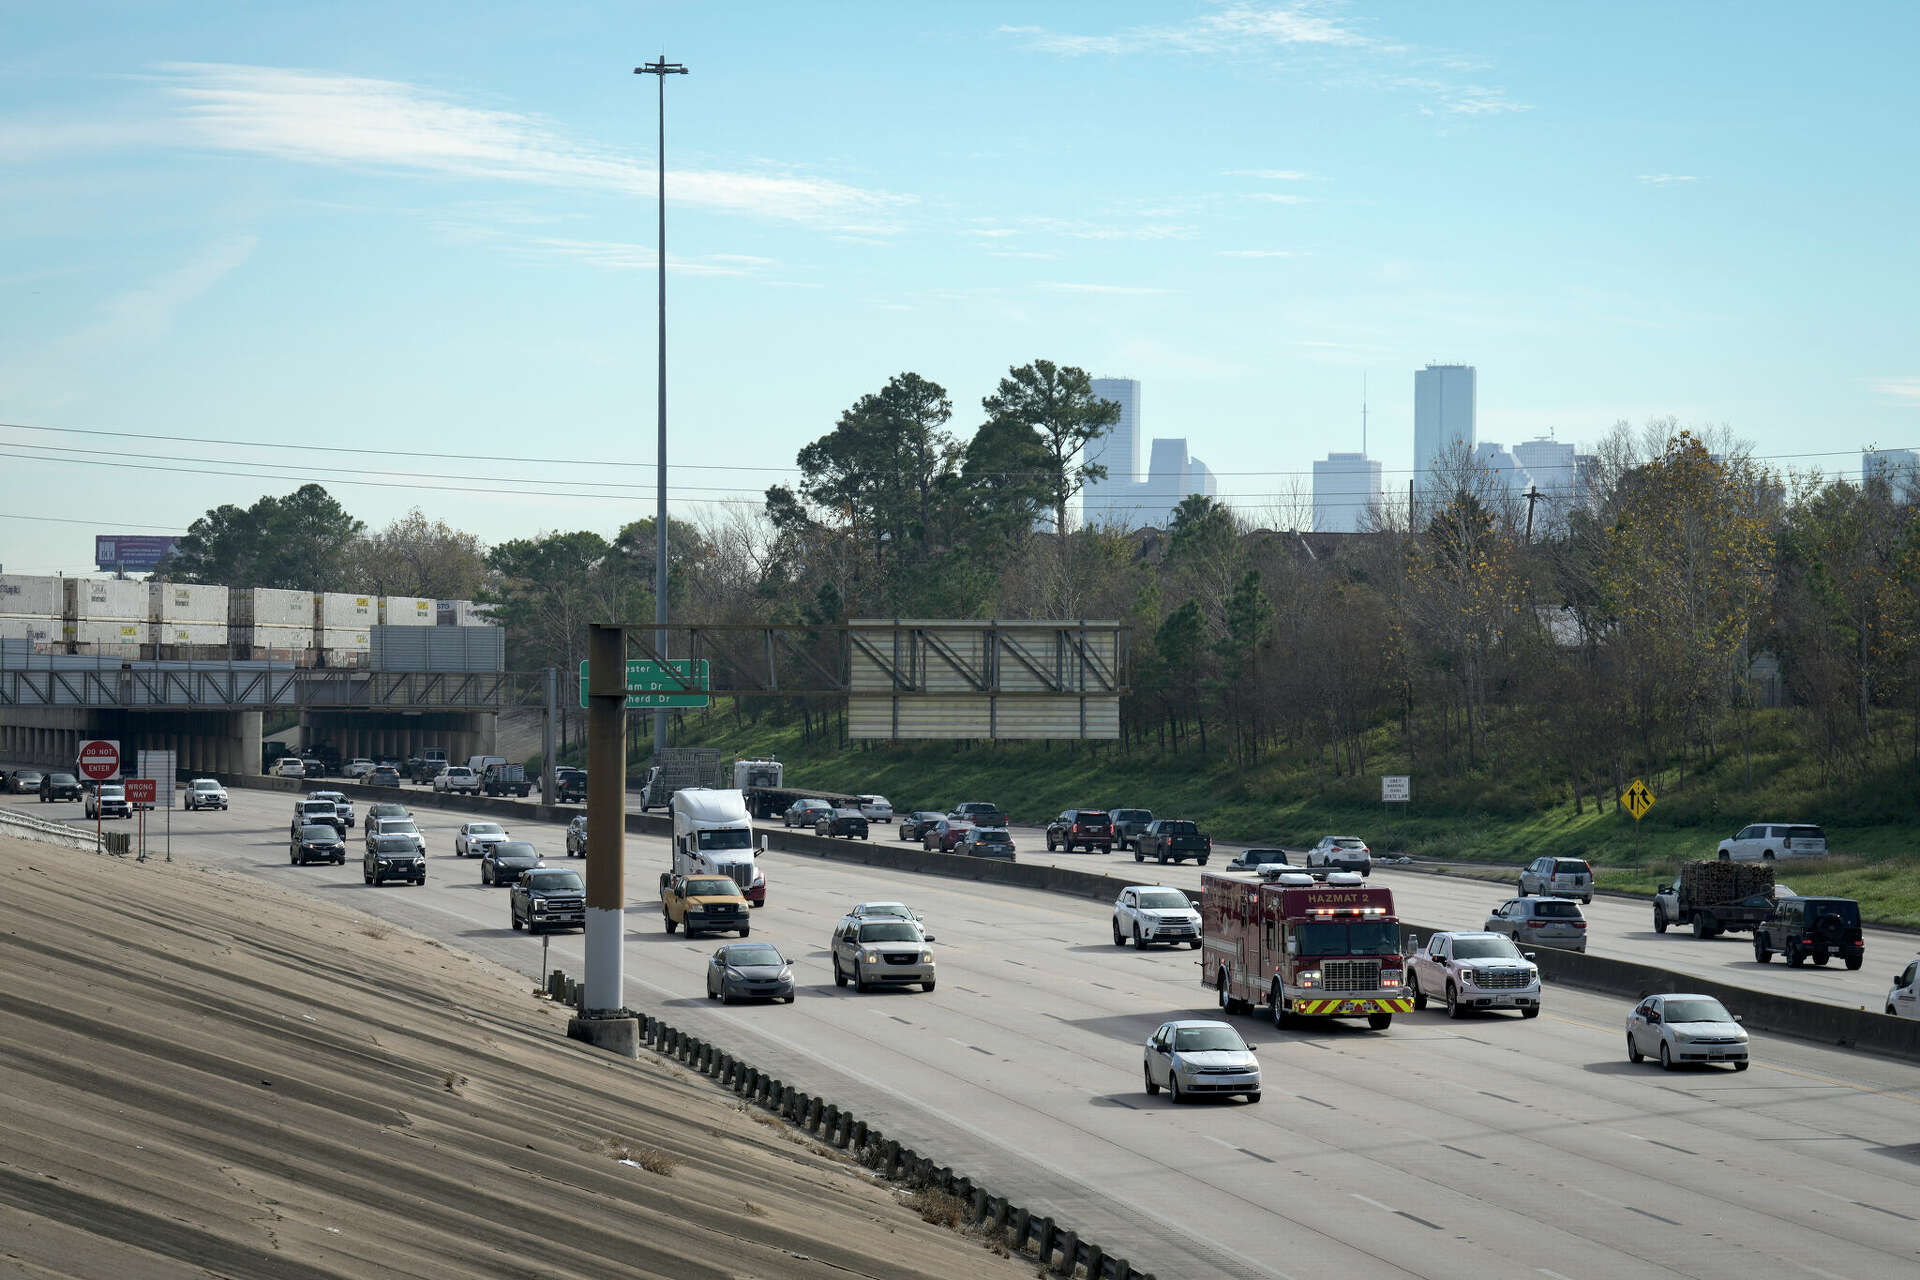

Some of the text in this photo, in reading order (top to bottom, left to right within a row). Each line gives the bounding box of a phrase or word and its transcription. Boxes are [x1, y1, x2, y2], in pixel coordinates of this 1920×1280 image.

[650, 682, 663, 691] Dr
[626, 694, 670, 703] herd Dr
[128, 783, 153, 791] WRONG
[132, 791, 148, 799] WAY
[1308, 893, 1369, 904] HAZMAT 2
